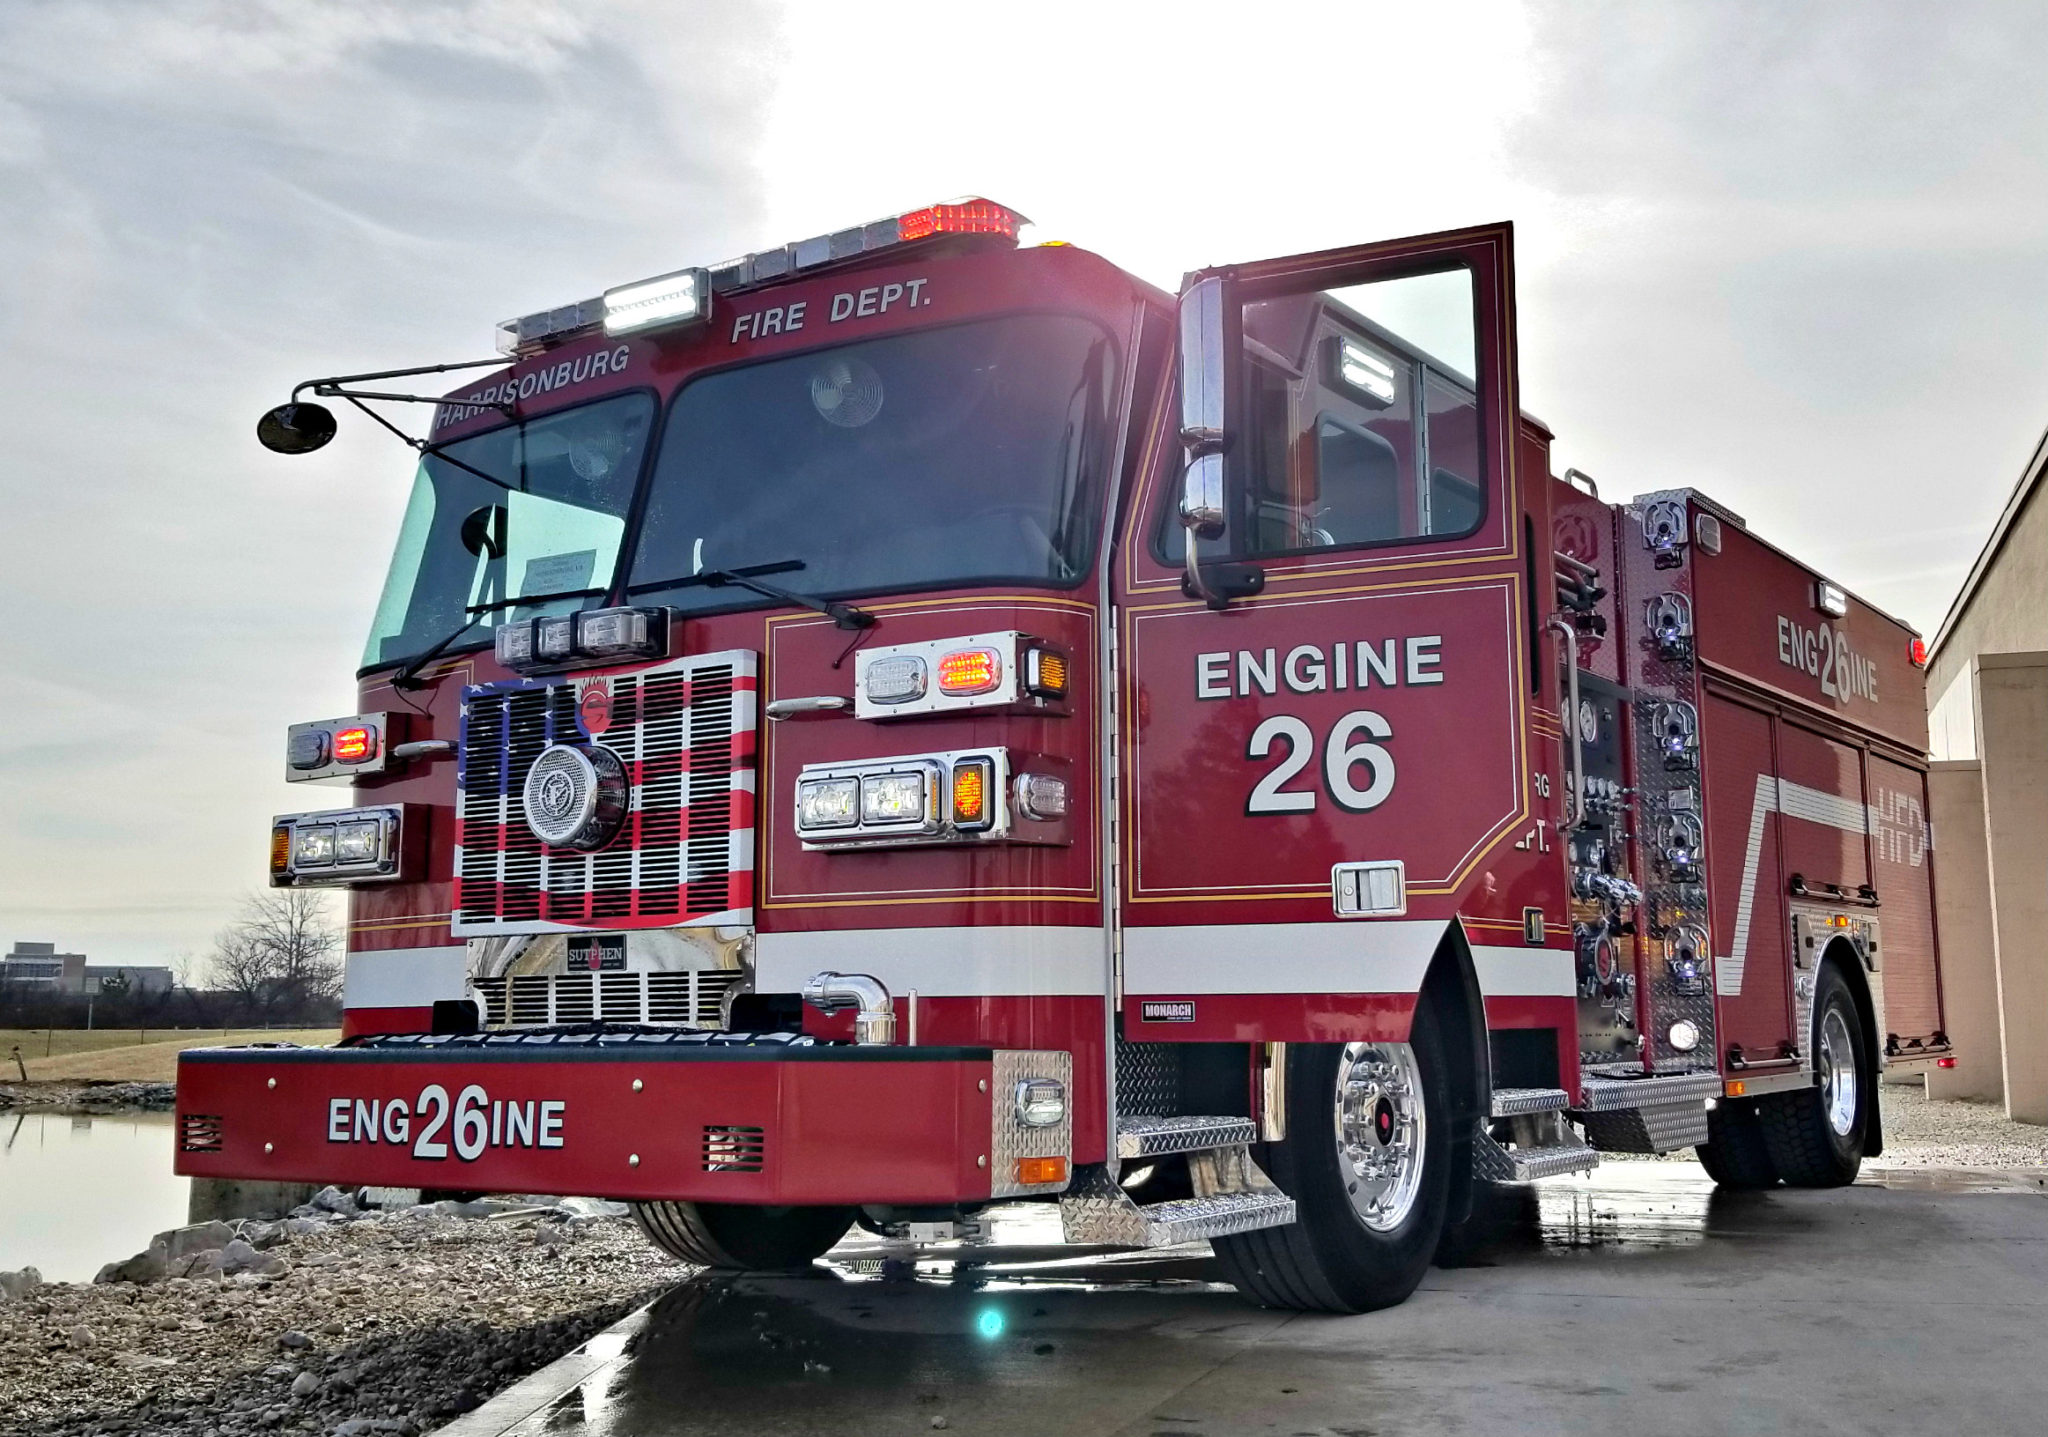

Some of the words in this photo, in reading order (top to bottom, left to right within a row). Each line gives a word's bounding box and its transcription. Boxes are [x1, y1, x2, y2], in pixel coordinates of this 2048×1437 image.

[731, 302, 807, 343] FIRE
[830, 278, 931, 322] DEPT.
[1197, 635, 1444, 698] ENGINE
[1247, 710, 1396, 815] 26
[1879, 787, 1923, 867] HFD
[568, 947, 623, 962] SUTPHEN
[1145, 1004, 1192, 1017] MONARCH
